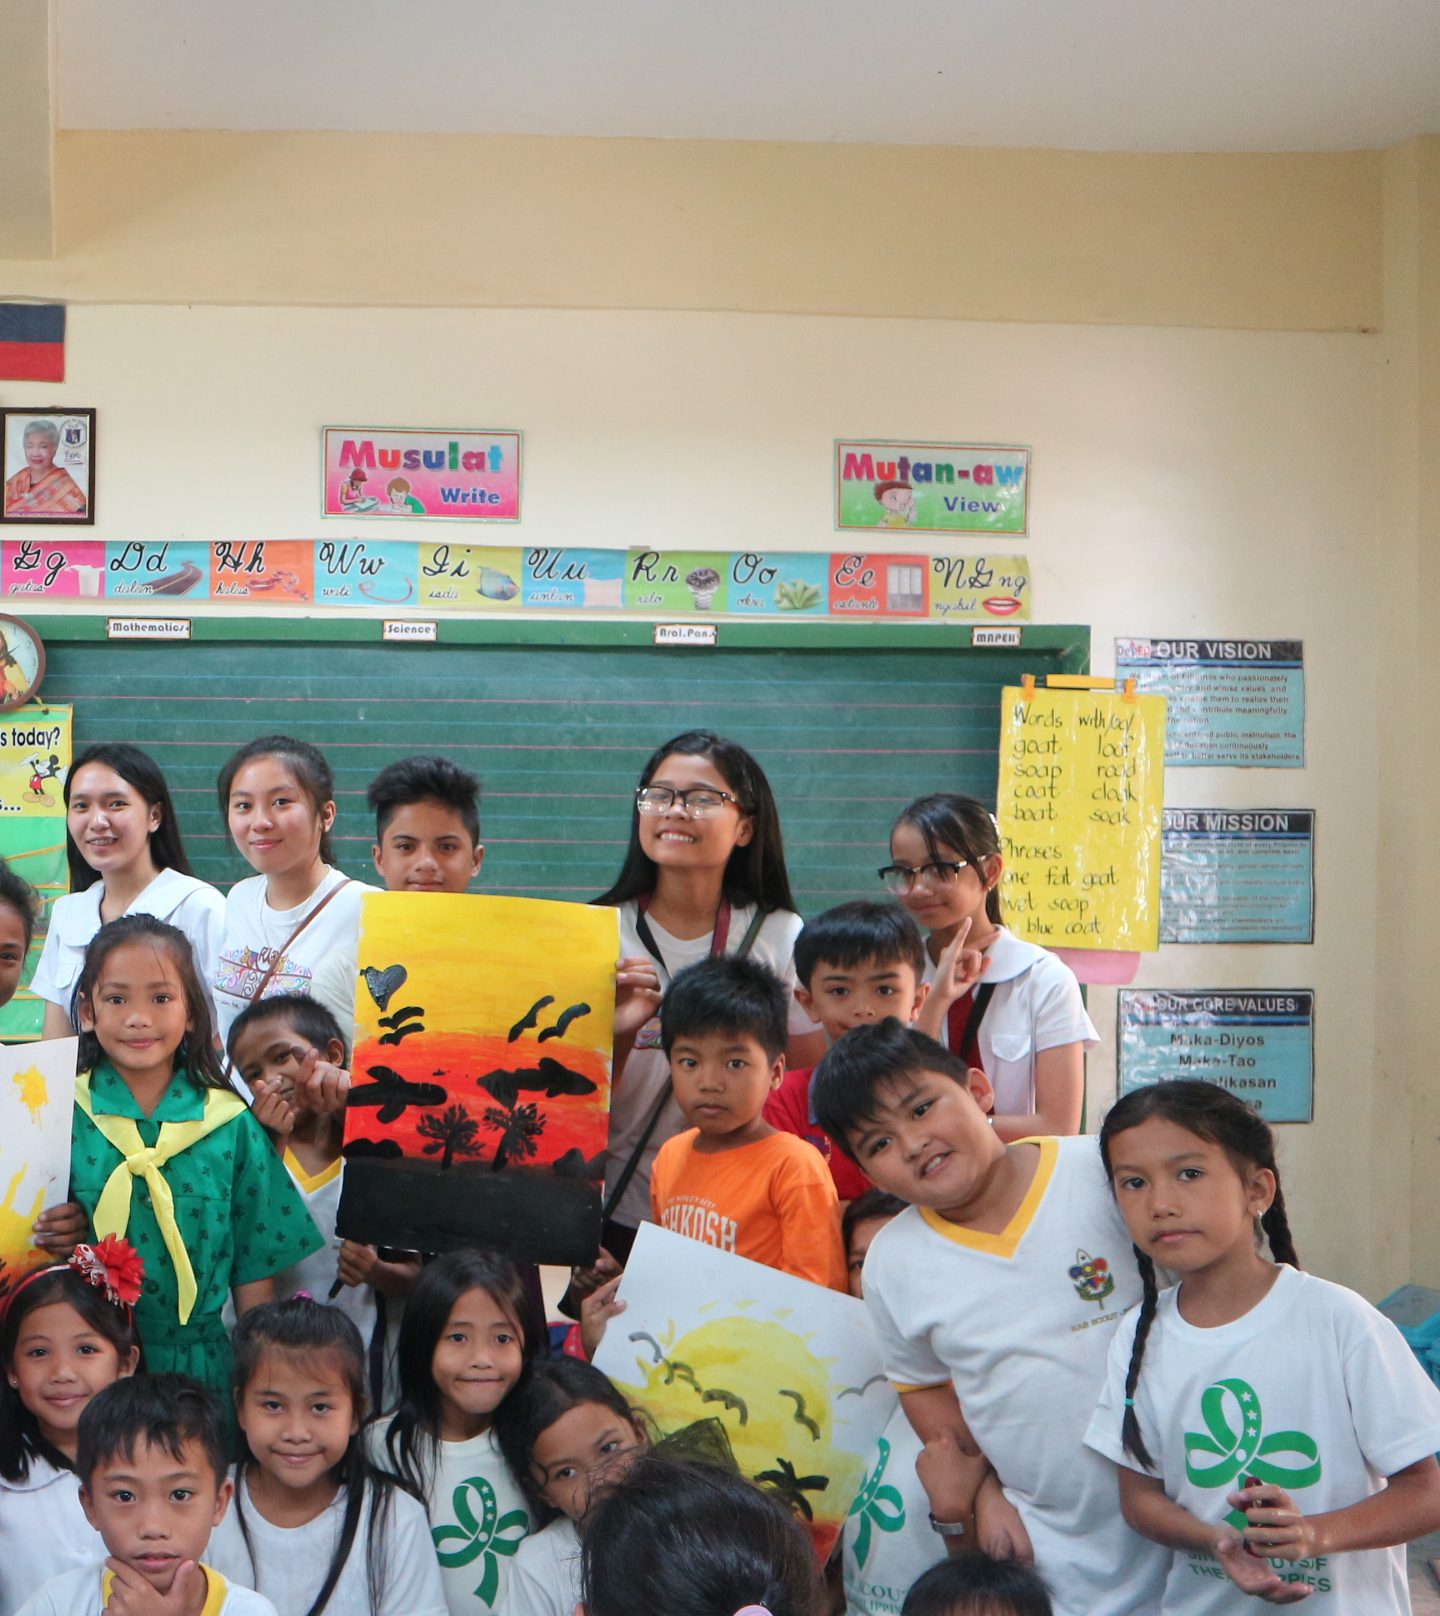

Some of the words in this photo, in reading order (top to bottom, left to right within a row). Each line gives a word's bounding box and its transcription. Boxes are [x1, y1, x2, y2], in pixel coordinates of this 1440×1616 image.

[339, 440, 504, 472] Musulat
[844, 452, 1024, 486] Mutan-aw
[440, 487, 500, 504] Write
[944, 496, 1000, 513] View
[113, 622, 184, 632] Mathematics
[388, 623, 431, 634] Science
[977, 633, 1016, 643] MAPEH
[1157, 641, 1199, 658] OUR
[1206, 642, 1271, 659] VISION
[1015, 703, 1062, 728] Words
[1080, 709, 1106, 727] with
[12, 726, 60, 750] today?
[1014, 734, 1062, 760] goat
[1098, 735, 1134, 757] loaf
[1014, 763, 1062, 782] soap
[1098, 764, 1136, 778] road
[1014, 781, 1059, 798] coat
[1092, 782, 1137, 801] cloak
[1014, 803, 1057, 822] boat
[1090, 807, 1130, 825] soak
[1206, 815, 1289, 831] MISSION
[1002, 870, 1030, 885] one
[1046, 866, 1072, 885] fat
[1083, 866, 1119, 890] goat
[1048, 899, 1089, 919] soap
[1027, 917, 1053, 935] blue
[1065, 917, 1101, 935] coat
[1159, 998, 1188, 1012] OUR
[1193, 998, 1234, 1012] CORE
[1239, 998, 1296, 1012] VALUES
[1188, 1563, 1224, 1580] THE
